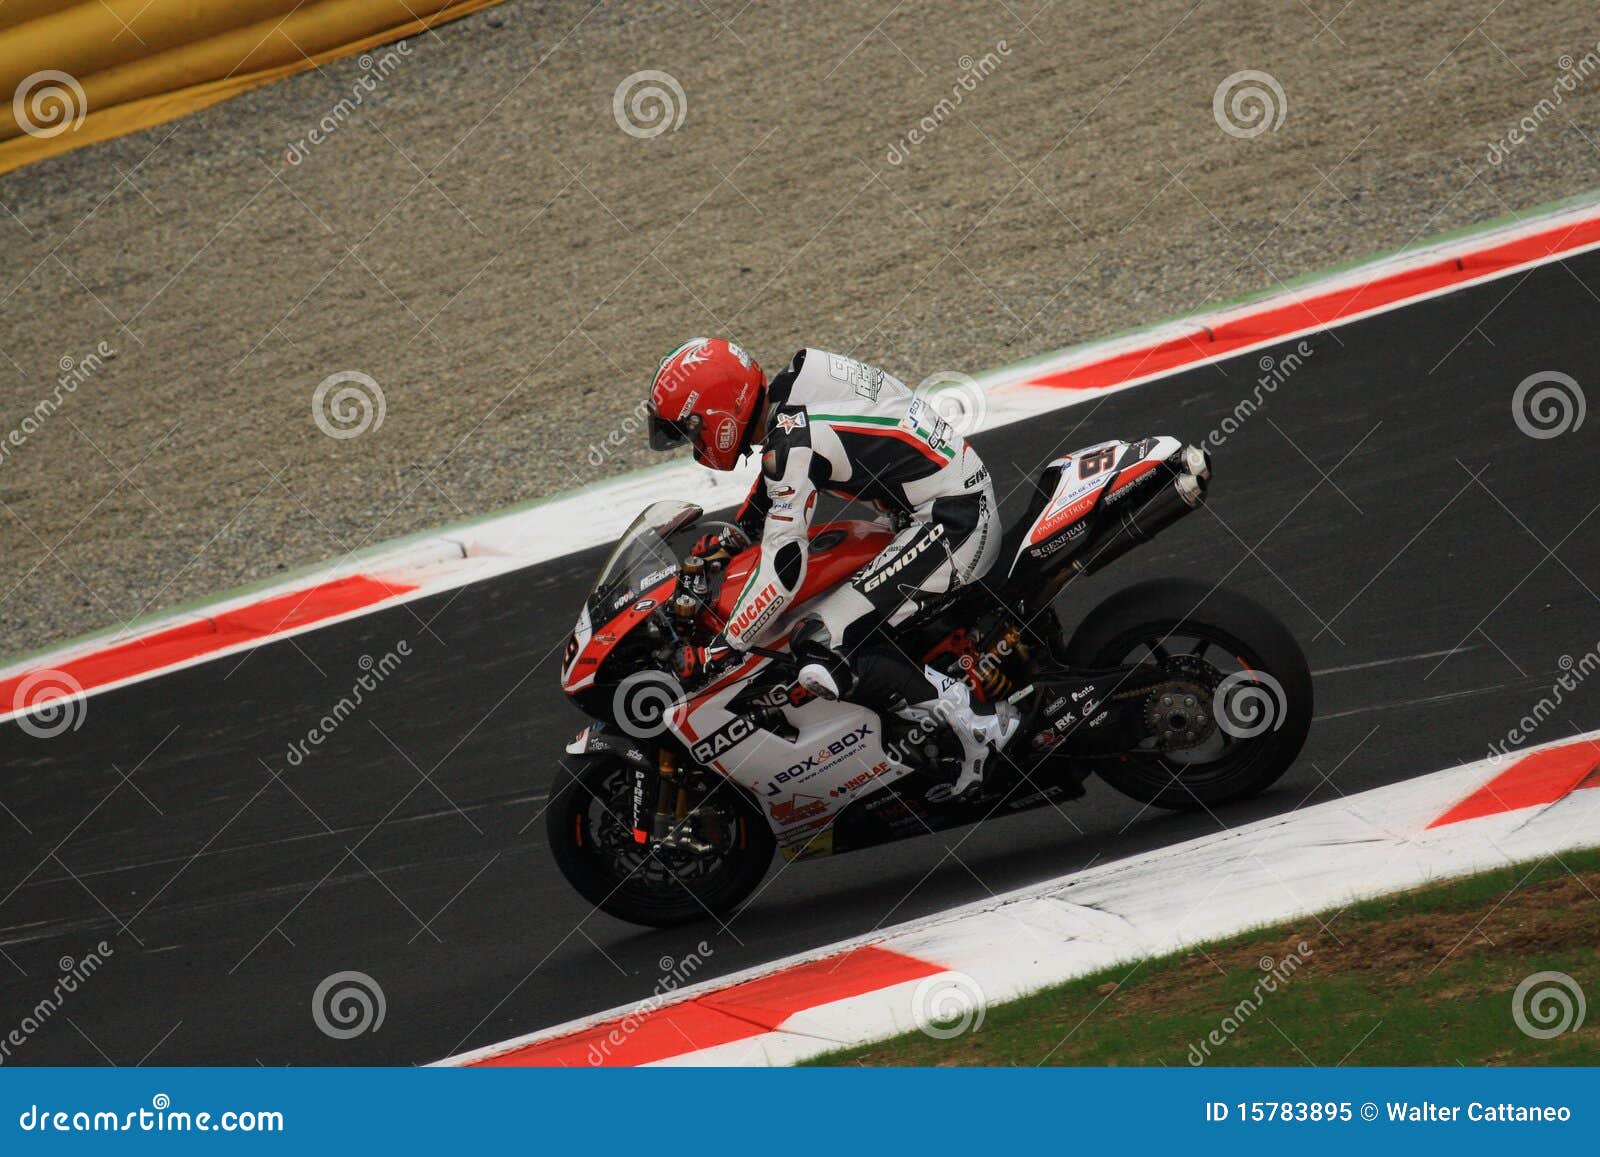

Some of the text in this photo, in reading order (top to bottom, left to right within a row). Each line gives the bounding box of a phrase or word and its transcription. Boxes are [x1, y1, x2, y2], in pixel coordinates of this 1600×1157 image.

[1037, 499, 1093, 536] PARAMETRICA
[1041, 520, 1087, 553] GENERALI
[729, 583, 778, 638] DUCATI
[1055, 711, 1075, 731] RK
[844, 761, 889, 790] INPLAF
